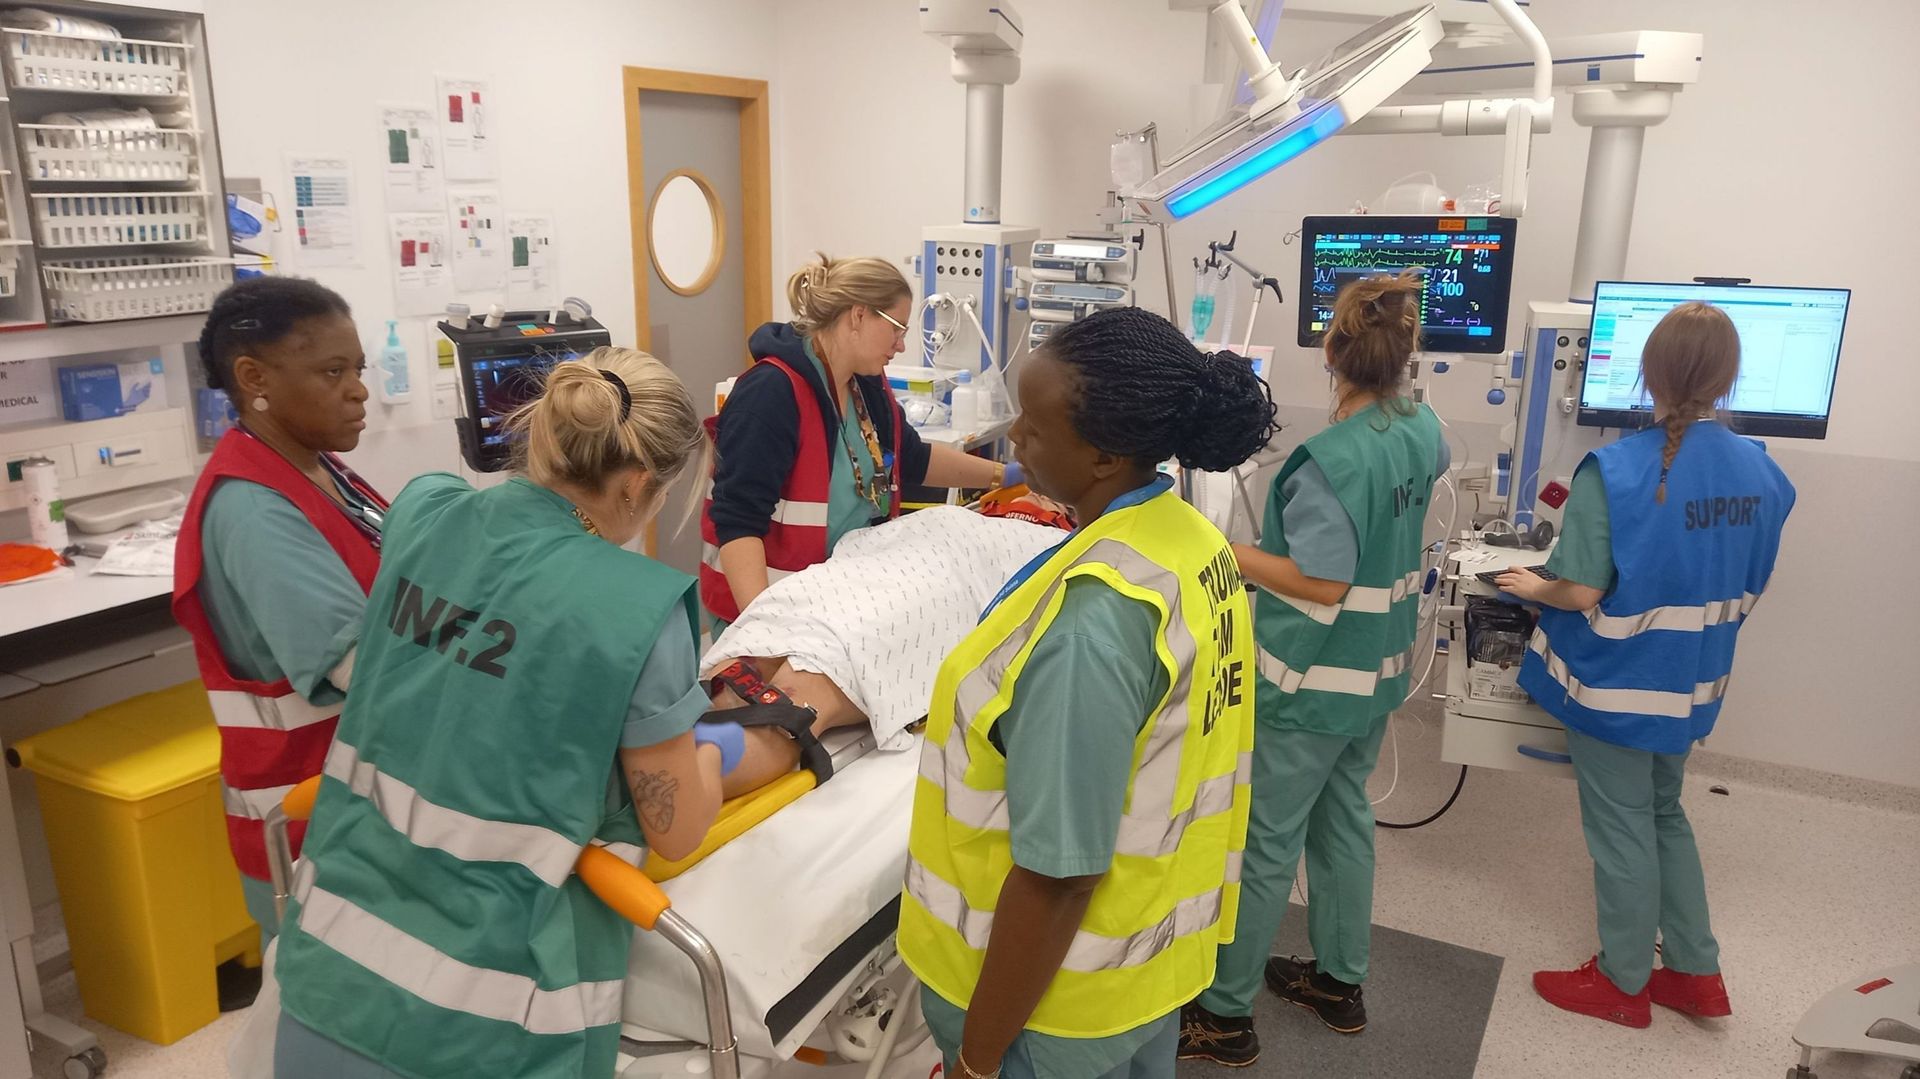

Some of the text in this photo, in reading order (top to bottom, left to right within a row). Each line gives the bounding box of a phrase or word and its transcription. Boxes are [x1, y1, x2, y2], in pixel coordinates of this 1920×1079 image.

[1444, 249, 1463, 265] 74
[1480, 249, 1489, 258] 71
[1442, 269, 1458, 283] 21
[1441, 283, 1464, 296] 100
[1318, 310, 1335, 320] 14:4
[1684, 495, 1761, 531] SUPORT
[387, 576, 517, 680] INF.2
